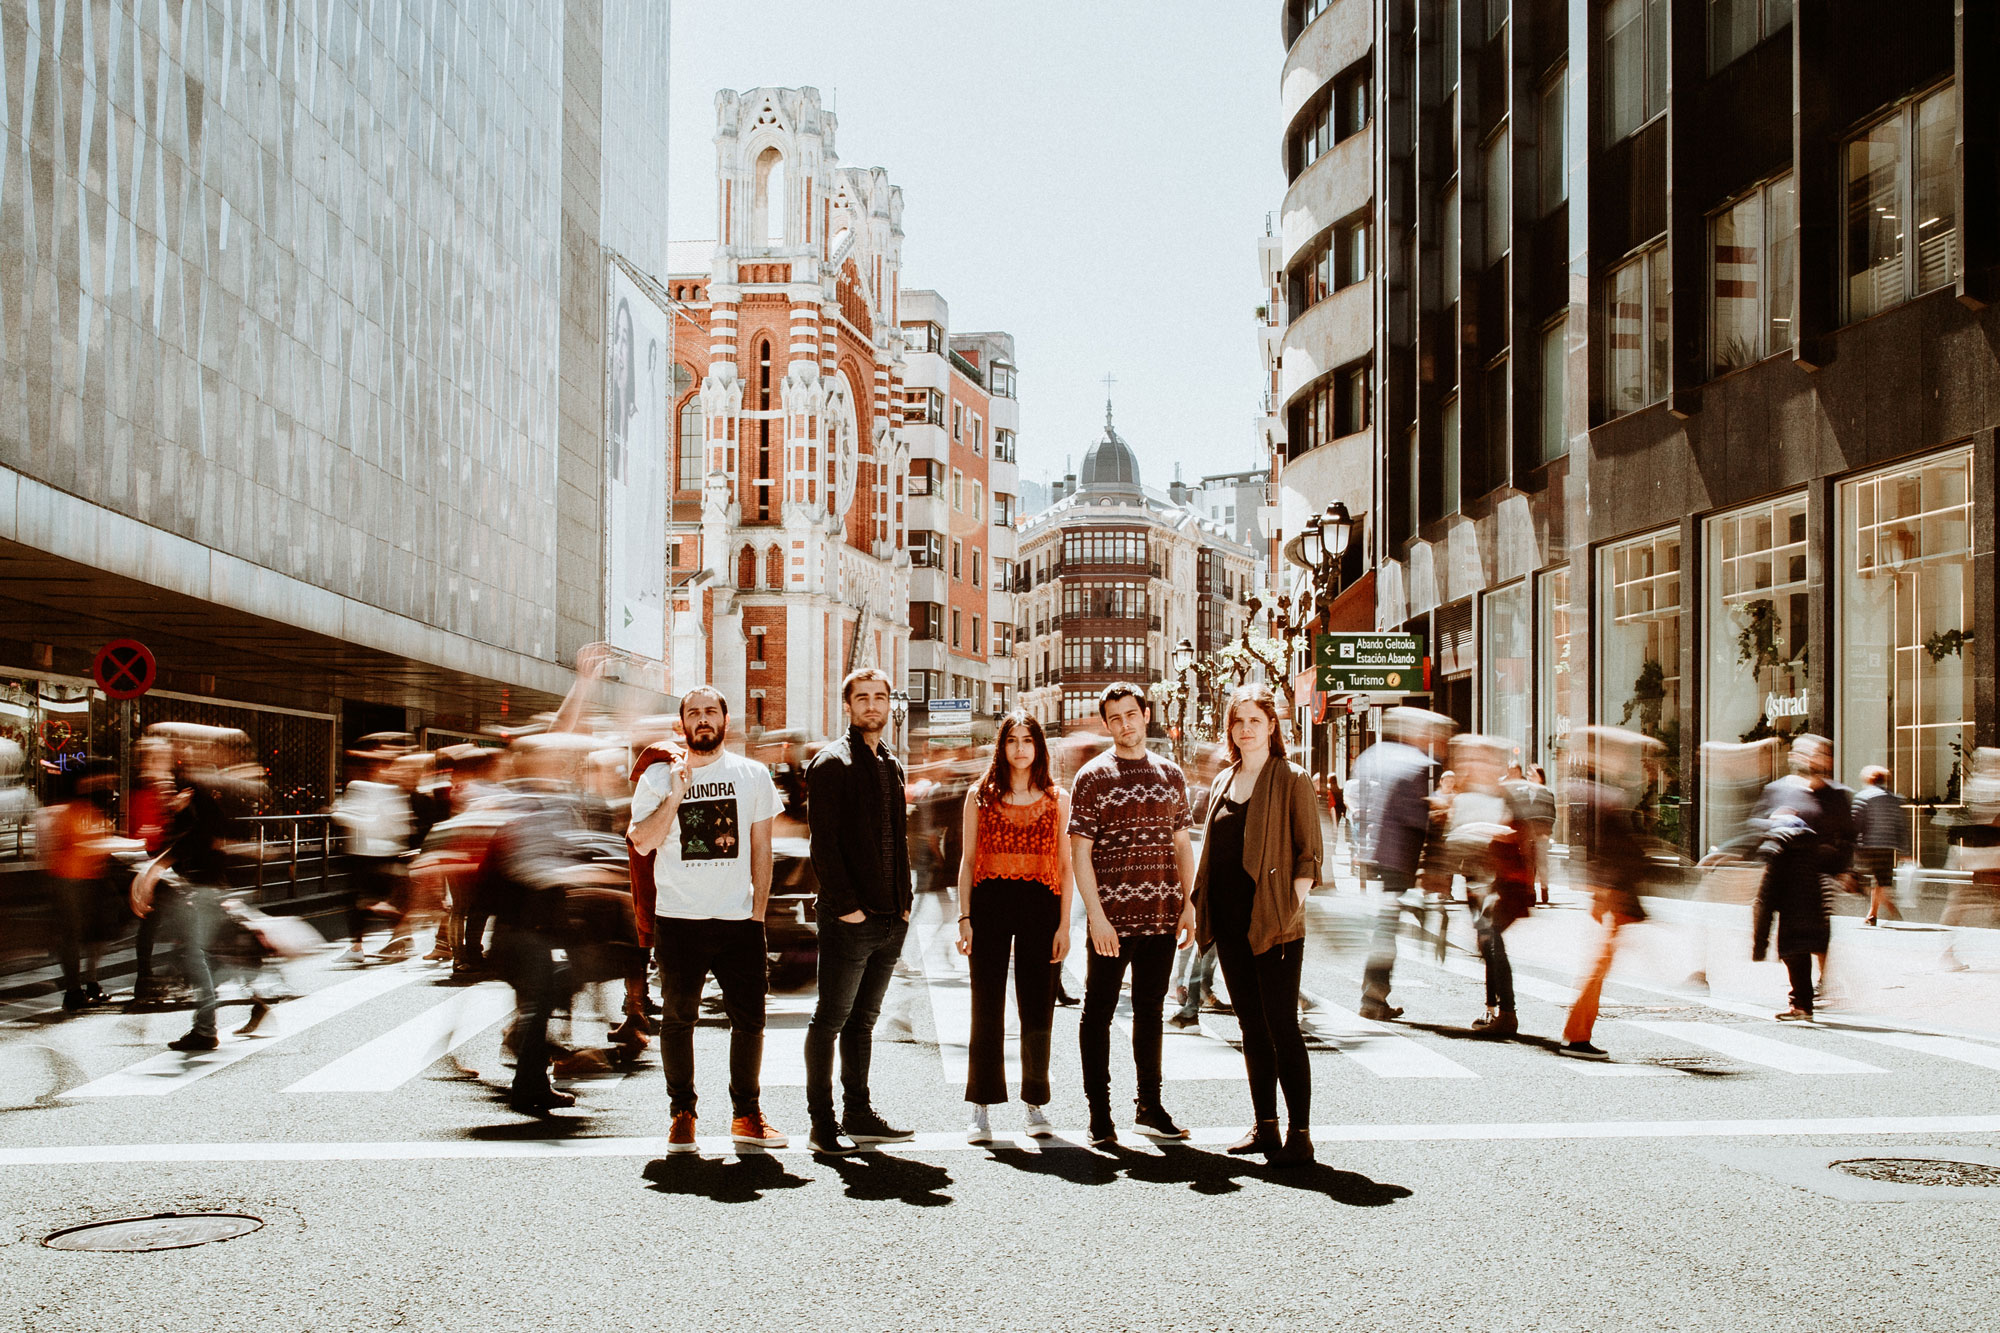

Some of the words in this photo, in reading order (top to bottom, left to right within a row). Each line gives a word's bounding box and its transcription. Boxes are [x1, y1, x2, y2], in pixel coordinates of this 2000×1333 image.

[1356, 638, 1383, 649] Abando
[1385, 638, 1416, 650] Geltokia
[1356, 652, 1386, 663] Estación
[1387, 653, 1416, 663] Abando
[1348, 673, 1385, 686] Turismo
